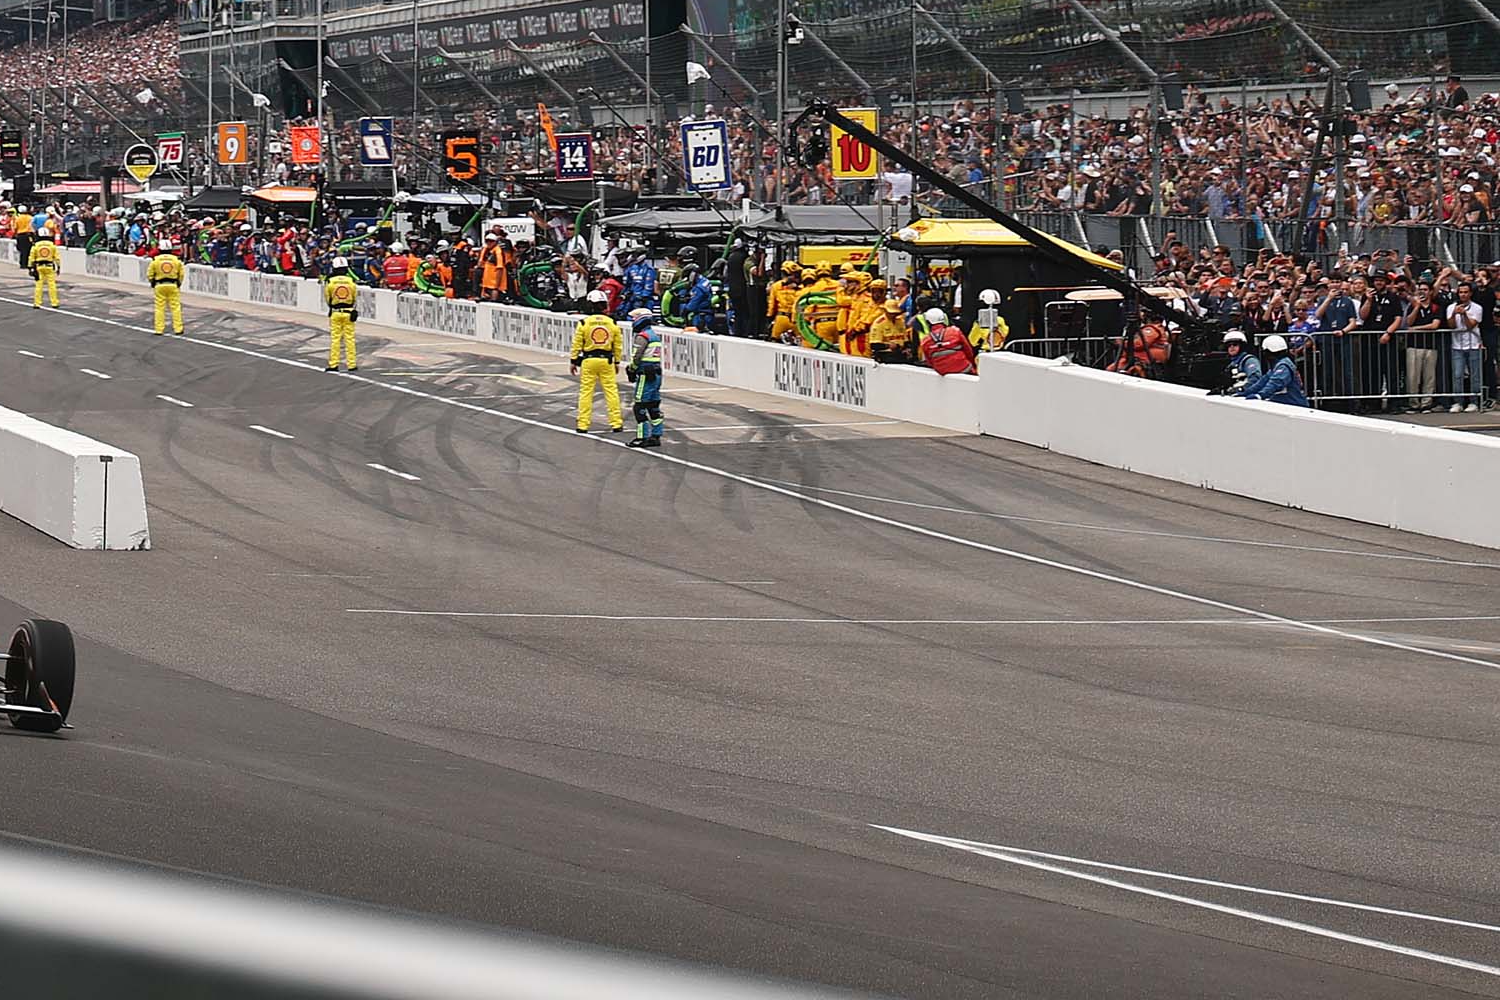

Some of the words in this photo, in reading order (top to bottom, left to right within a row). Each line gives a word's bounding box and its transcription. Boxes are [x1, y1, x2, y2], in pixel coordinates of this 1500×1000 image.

[162, 144, 180, 160] 75
[226, 137, 239, 160] 9
[362, 135, 390, 159] 8
[445, 137, 478, 179] 5
[561, 146, 587, 169] 14
[692, 145, 719, 167] 60
[837, 134, 871, 172] 10
